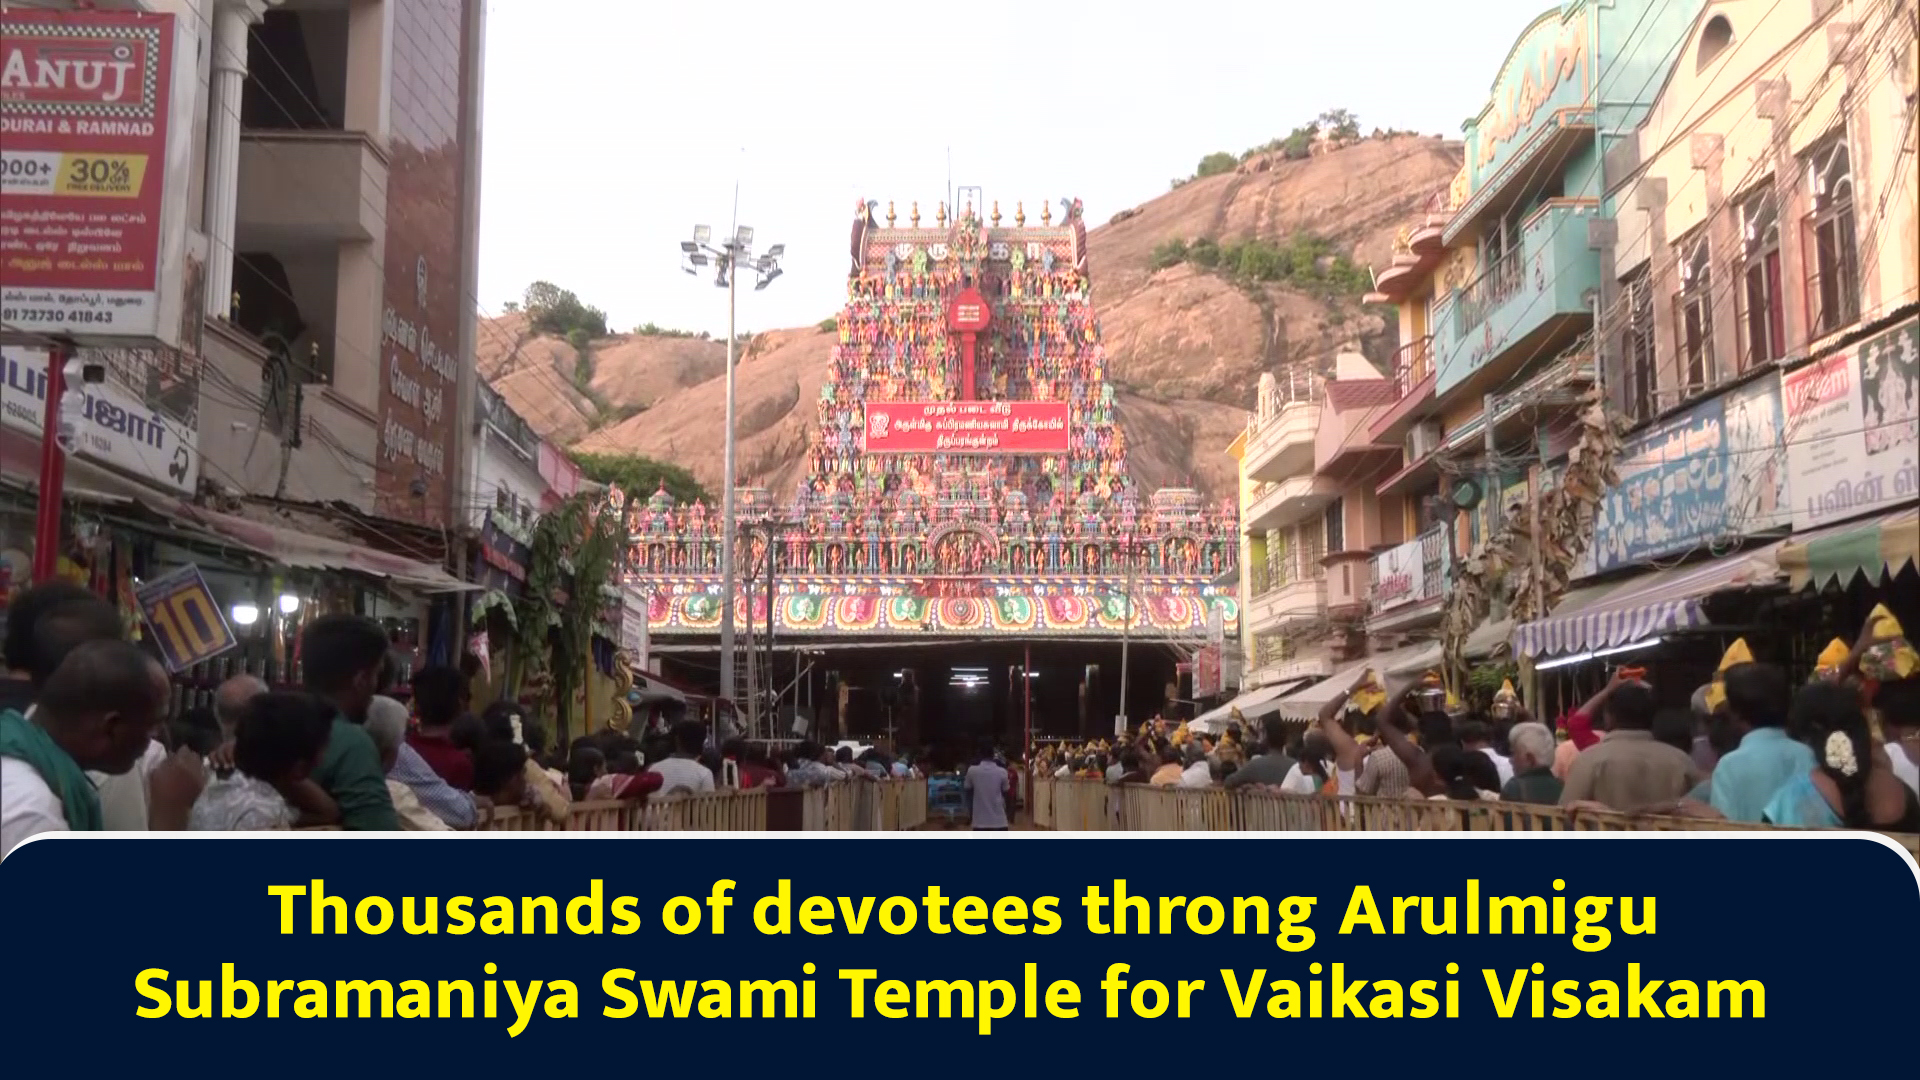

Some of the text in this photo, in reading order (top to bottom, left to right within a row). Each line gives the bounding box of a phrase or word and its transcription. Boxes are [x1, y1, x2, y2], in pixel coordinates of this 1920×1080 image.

[1, 49, 136, 101] ANUJ
[58, 119, 71, 134] &
[76, 120, 155, 136] RAMNAD
[70, 159, 130, 183] 30%
[21, 309, 64, 321] 73730
[68, 311, 113, 323] 41843
[153, 586, 227, 664] 10
